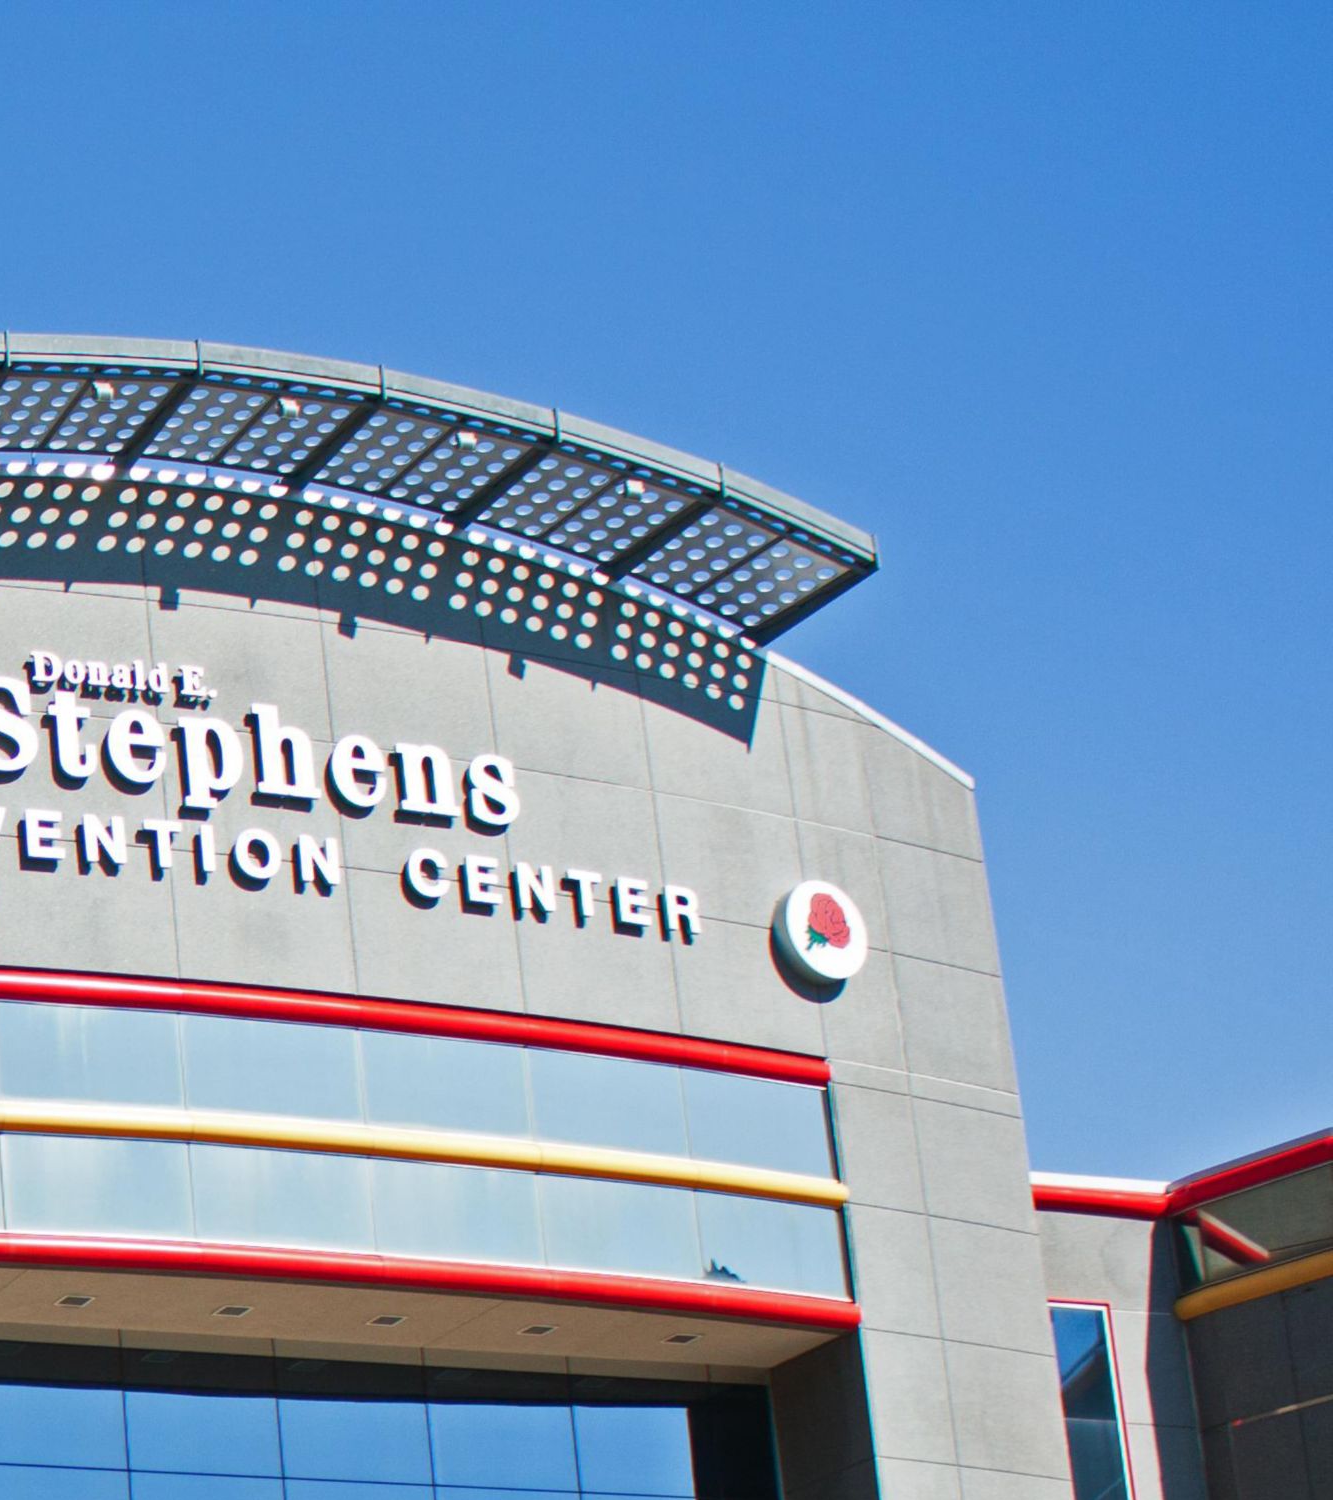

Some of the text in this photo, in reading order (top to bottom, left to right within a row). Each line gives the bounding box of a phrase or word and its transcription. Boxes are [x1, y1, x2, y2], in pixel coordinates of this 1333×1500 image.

[29, 651, 218, 699] Donald E.
[407, 848, 702, 935] CENTER
